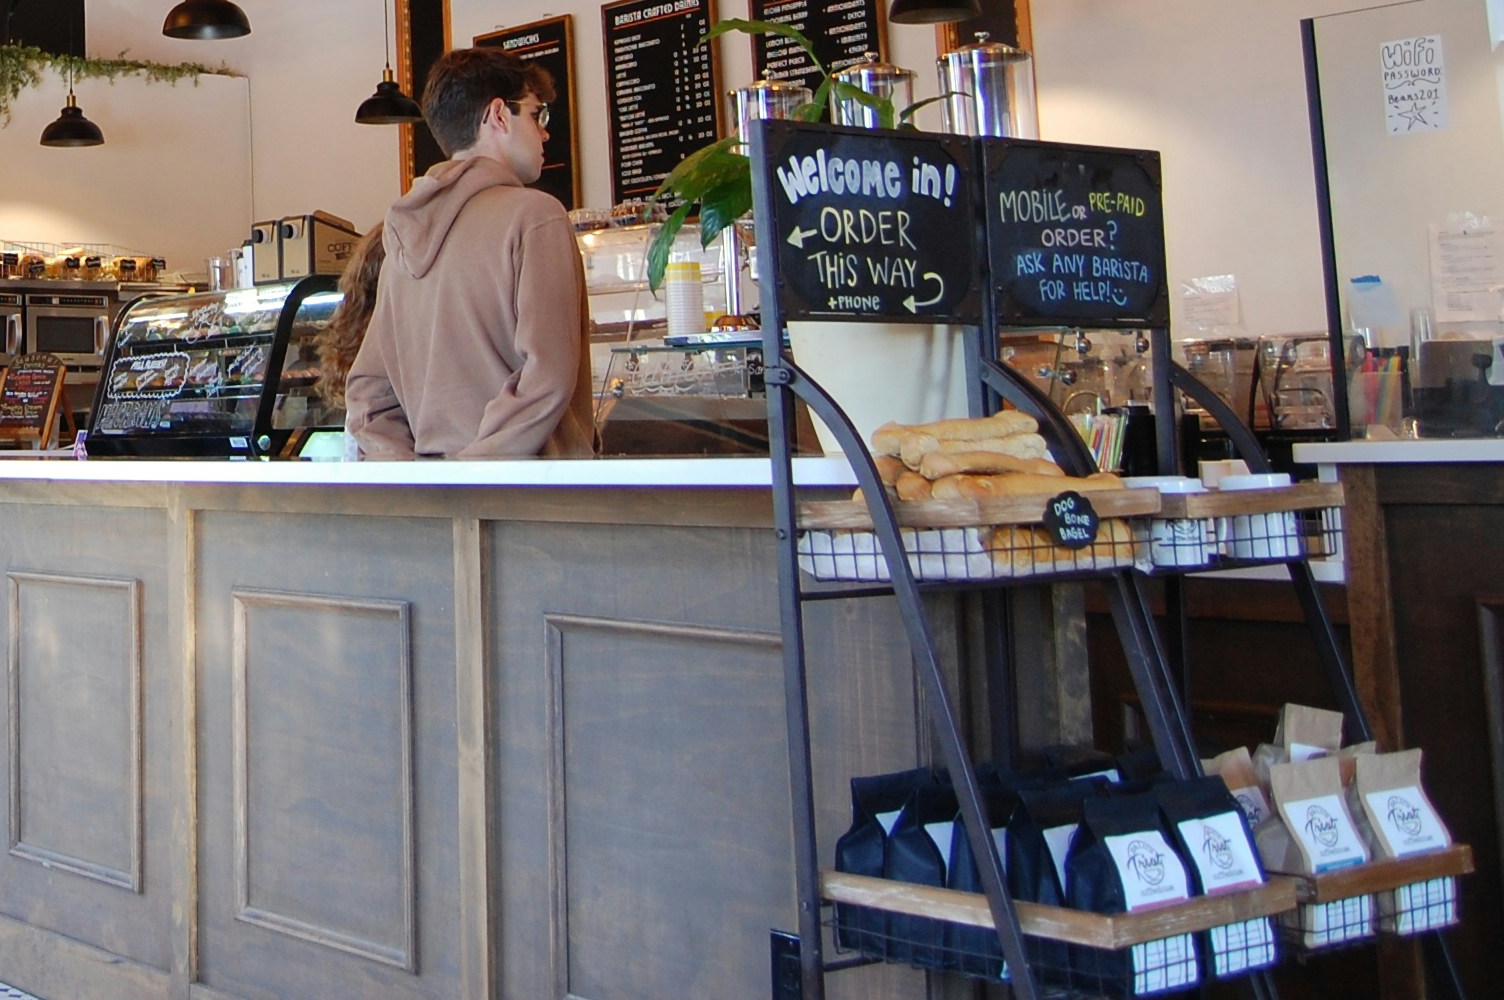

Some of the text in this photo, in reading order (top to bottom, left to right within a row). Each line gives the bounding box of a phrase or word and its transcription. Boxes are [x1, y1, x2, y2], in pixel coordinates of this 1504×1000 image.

[912, 156, 955, 207] in!
[1089, 192, 1145, 217] PRE-PAID
[820, 206, 917, 250] ORDER
[1041, 220, 1117, 250] ORDER?
[866, 256, 917, 288] WAY
[1017, 252, 1045, 276] ASK
[1052, 253, 1084, 278] ANY
[1039, 279, 1110, 303] FOR HELP!
[1054, 496, 1074, 516] DOG
[1064, 512, 1090, 526] BONE
[1059, 526, 1090, 540] BAGEL
